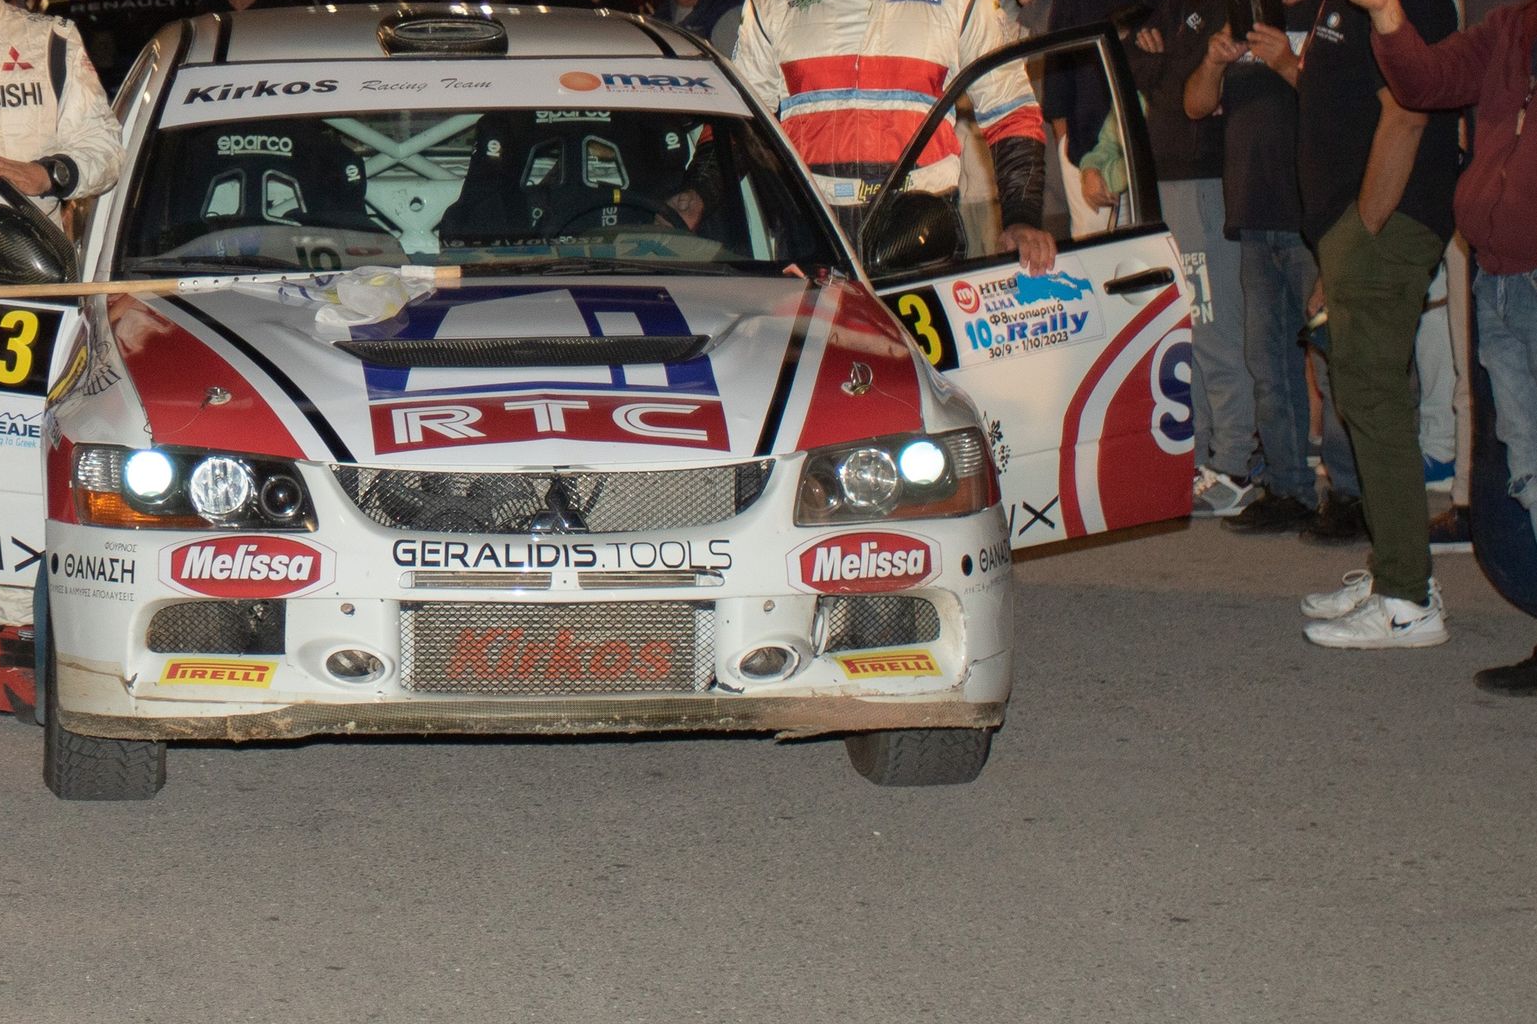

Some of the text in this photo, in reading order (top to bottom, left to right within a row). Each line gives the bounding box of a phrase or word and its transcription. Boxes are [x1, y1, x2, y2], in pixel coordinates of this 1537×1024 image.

[182, 77, 494, 105] Kirkos Racing Team
[217, 135, 292, 156] sparco
[898, 293, 942, 366] 3
[965, 318, 992, 350] 10
[1007, 311, 1089, 342] Rally
[989, 343, 1012, 359] 30/9
[1022, 332, 1069, 351] 1/10/2023
[390, 399, 708, 444] RTC
[104, 541, 137, 553] ΦΟΥΡΝΟΣ
[811, 542, 925, 582] Melissa
[64, 553, 135, 584] ΘΑΝΑΣΗ
[180, 544, 313, 582] Melissa
[444, 626, 677, 682] Kirkos
[842, 653, 935, 675] PIRELLI
[166, 662, 270, 683] PIRELLI
